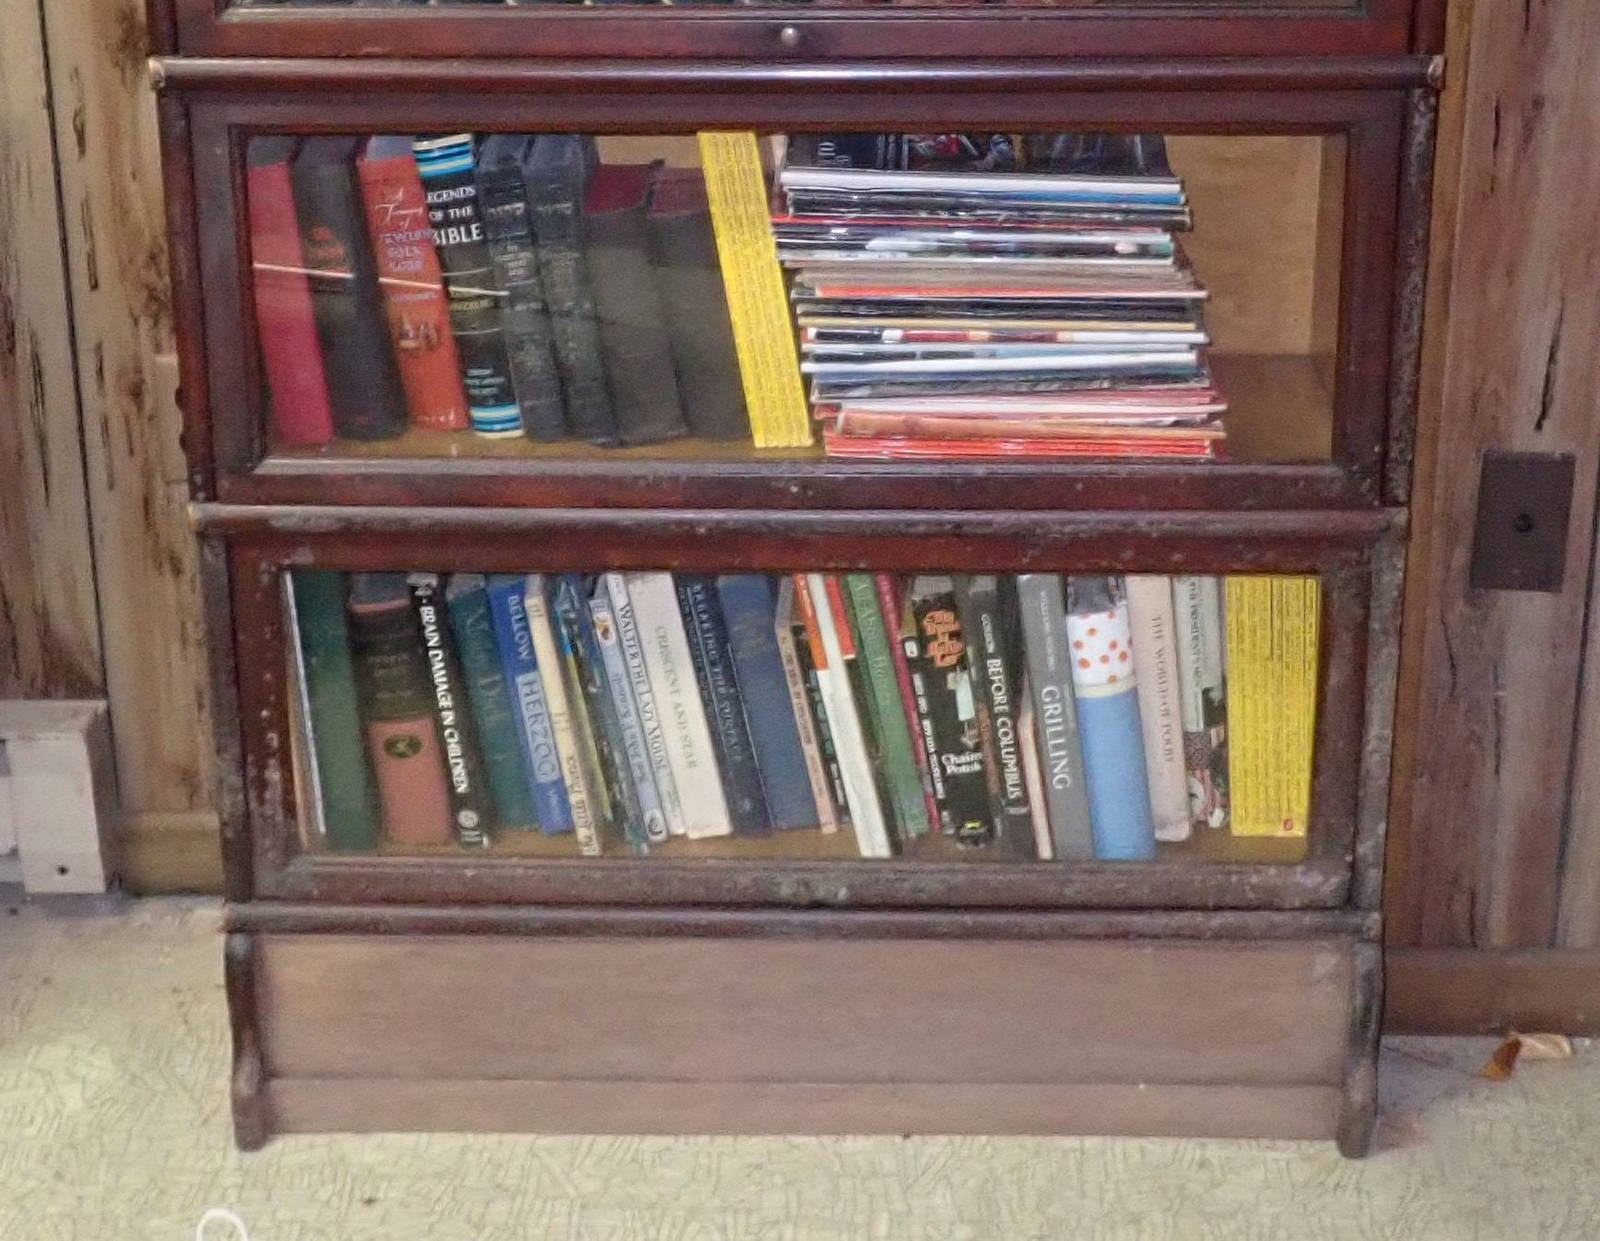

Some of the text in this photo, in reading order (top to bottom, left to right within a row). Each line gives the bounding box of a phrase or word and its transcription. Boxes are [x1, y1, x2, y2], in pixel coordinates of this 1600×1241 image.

[426, 185, 476, 203] EGENDS
[428, 209, 444, 222] OF
[449, 205, 473, 220] THE
[507, 595, 533, 660] BELLOW
[654, 624, 681, 696] CRESCENT
[419, 606, 470, 794] BRAIN DAMAGE IN CHILDREN
[617, 601, 668, 773] WALTER THE LAZY MOUSE
[672, 700, 690, 731] AND
[987, 657, 1009, 713] BEFORE
[1152, 617, 1174, 764] THE WORLD OF POOH
[519, 677, 560, 784] HERZOG
[680, 733, 698, 769] STAR
[941, 751, 983, 766] Chaim
[996, 716, 1022, 800] COLUMBUS
[1039, 684, 1073, 791] GRILLING
[946, 763, 982, 774] Potok
